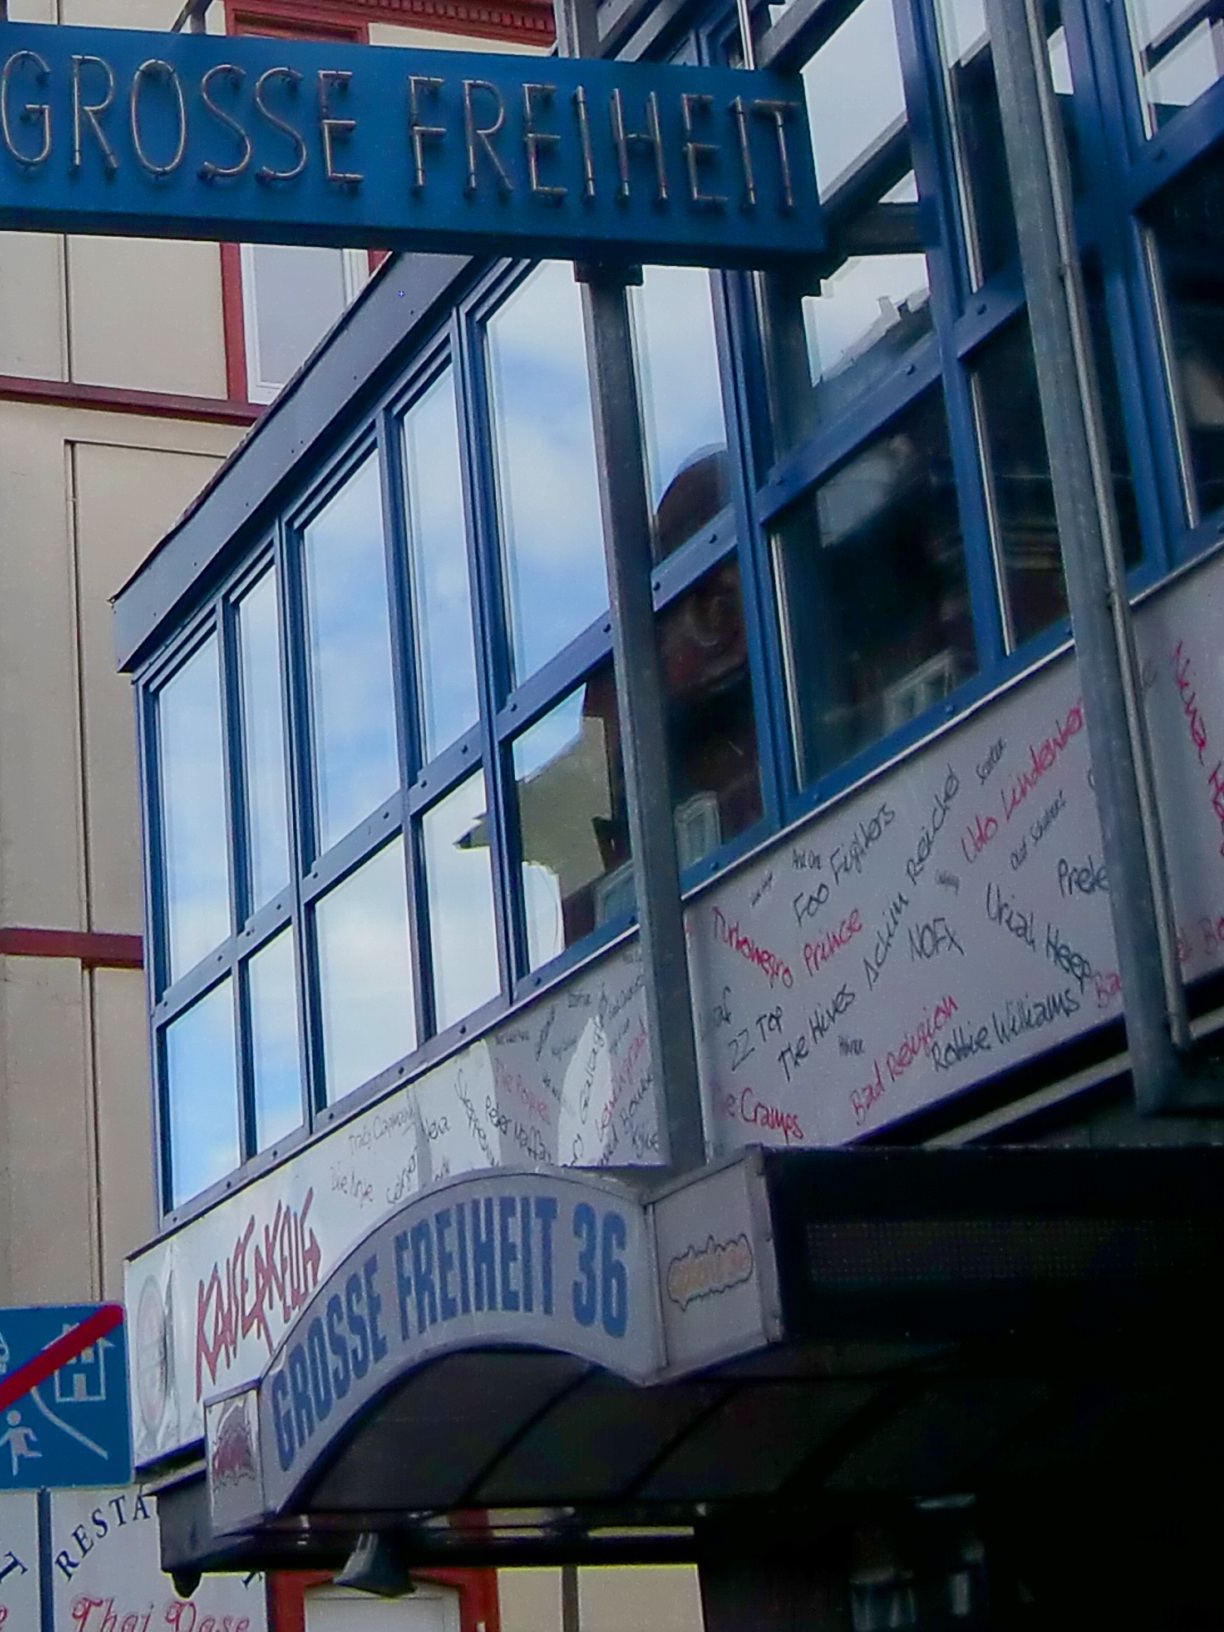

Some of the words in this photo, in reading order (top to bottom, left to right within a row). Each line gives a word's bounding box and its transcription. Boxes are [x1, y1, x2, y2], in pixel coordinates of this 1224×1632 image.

[0, 50, 364, 184] GROSSE
[407, 75, 799, 209] FREIHEIT
[793, 882, 830, 928] Foo
[829, 802, 896, 886] Fighters
[863, 891, 910, 991] Achim
[905, 763, 961, 886] Reichel
[961, 815, 999, 865] Udo
[803, 908, 863, 978] Prince
[907, 917, 966, 961] NOFX
[727, 1028, 756, 1072] ZZ
[777, 1035, 810, 1082] The
[808, 983, 856, 1045] Hives
[849, 1059, 886, 1126] Bad
[885, 994, 959, 1082] Religion
[928, 1020, 993, 1073] Robbie
[992, 988, 1081, 1046] Williams
[739, 1086, 805, 1145] Cramps
[271, 1254, 388, 1472] GROSSE
[394, 1196, 558, 1342] FREIHEIT
[573, 1202, 630, 1339] 36
